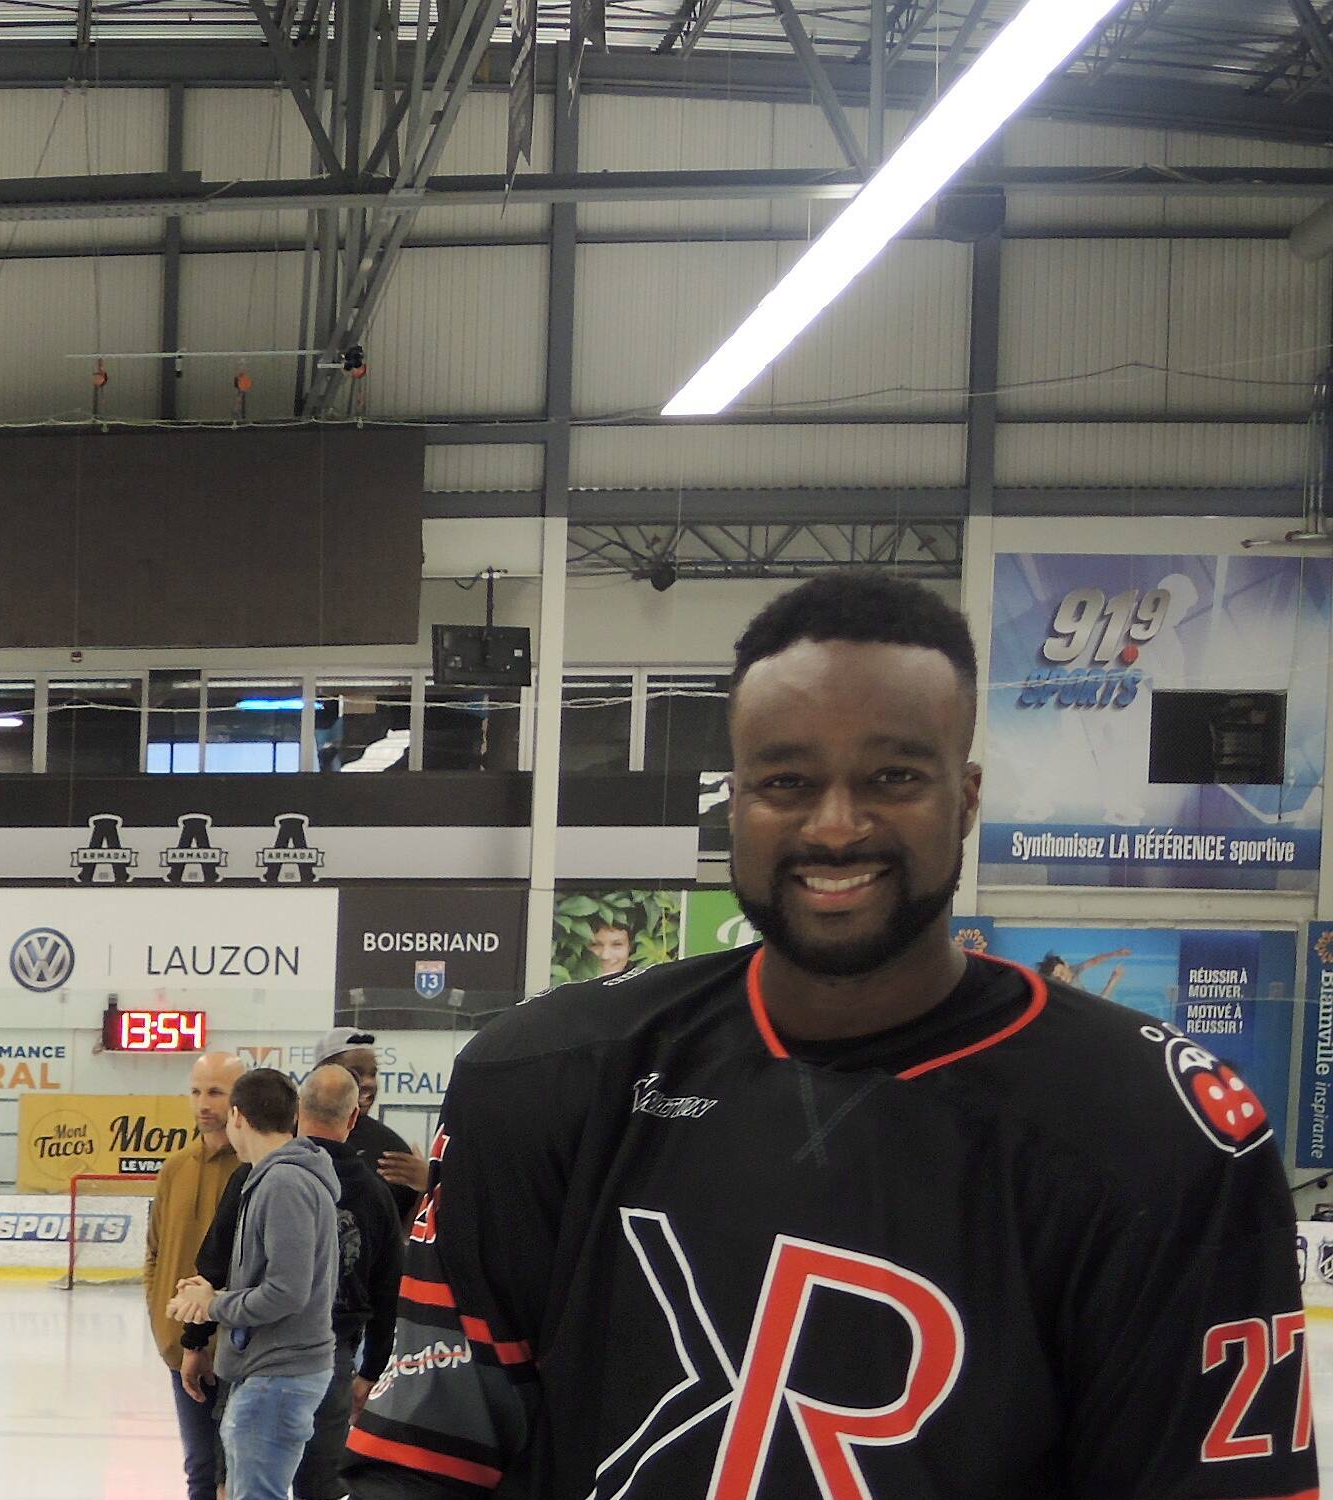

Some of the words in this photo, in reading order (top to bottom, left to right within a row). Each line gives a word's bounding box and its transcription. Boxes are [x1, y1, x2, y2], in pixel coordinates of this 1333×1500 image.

[1017, 667, 1143, 709] SPORTS
[1012, 831, 1105, 861] Synthonisez
[1109, 835, 1129, 859] LA
[1134, 828, 1225, 861] RÉFÉRENCE
[1229, 837, 1295, 865] sportive
[82, 851, 130, 861] ARMADA
[171, 852, 217, 860] ARMADA
[268, 852, 314, 860] ARMADA
[364, 932, 499, 952] BOISBRIAND
[147, 945, 300, 976] LAUZON
[420, 973, 438, 989] 13
[1189, 968, 1237, 984] RÉUSSIR
[1238, 966, 1248, 984] À
[1189, 984, 1244, 999] MOTIVER.
[1187, 1002, 1232, 1019] MOTIVÉ
[1233, 1002, 1243, 1019] À
[121, 1012, 202, 1049] 13:54
[1187, 1016, 1236, 1034] RÉUSSIR
[1311, 1080, 1331, 1159] inspirante
[54, 1124, 87, 1139] Mont
[34, 1136, 94, 1158] Tacos
[122, 1160, 138, 1171] LE
[1199, 1309, 1315, 1463] 27
